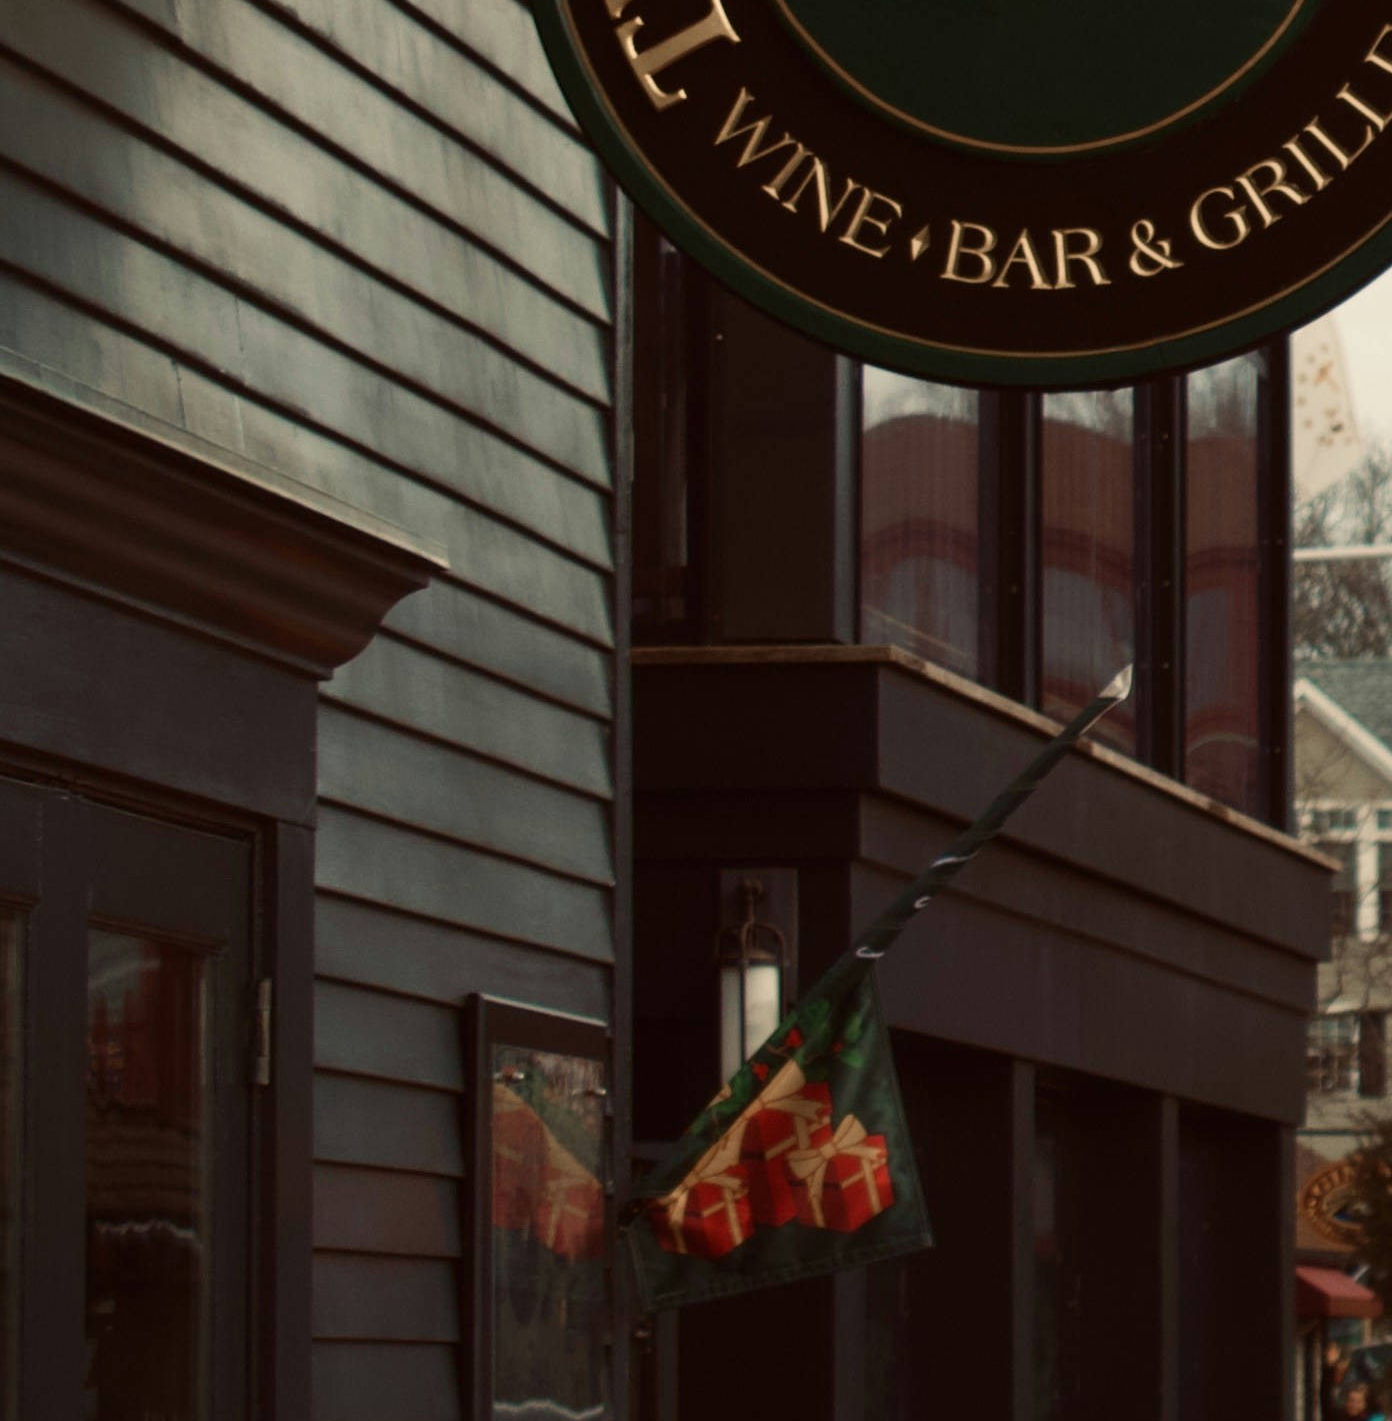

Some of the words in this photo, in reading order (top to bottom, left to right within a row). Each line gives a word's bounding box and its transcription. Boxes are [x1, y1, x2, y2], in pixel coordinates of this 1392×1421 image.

[711, 86, 904, 259] WINE
[940, 220, 1111, 290] BAR
[1128, 219, 1180, 277] &
